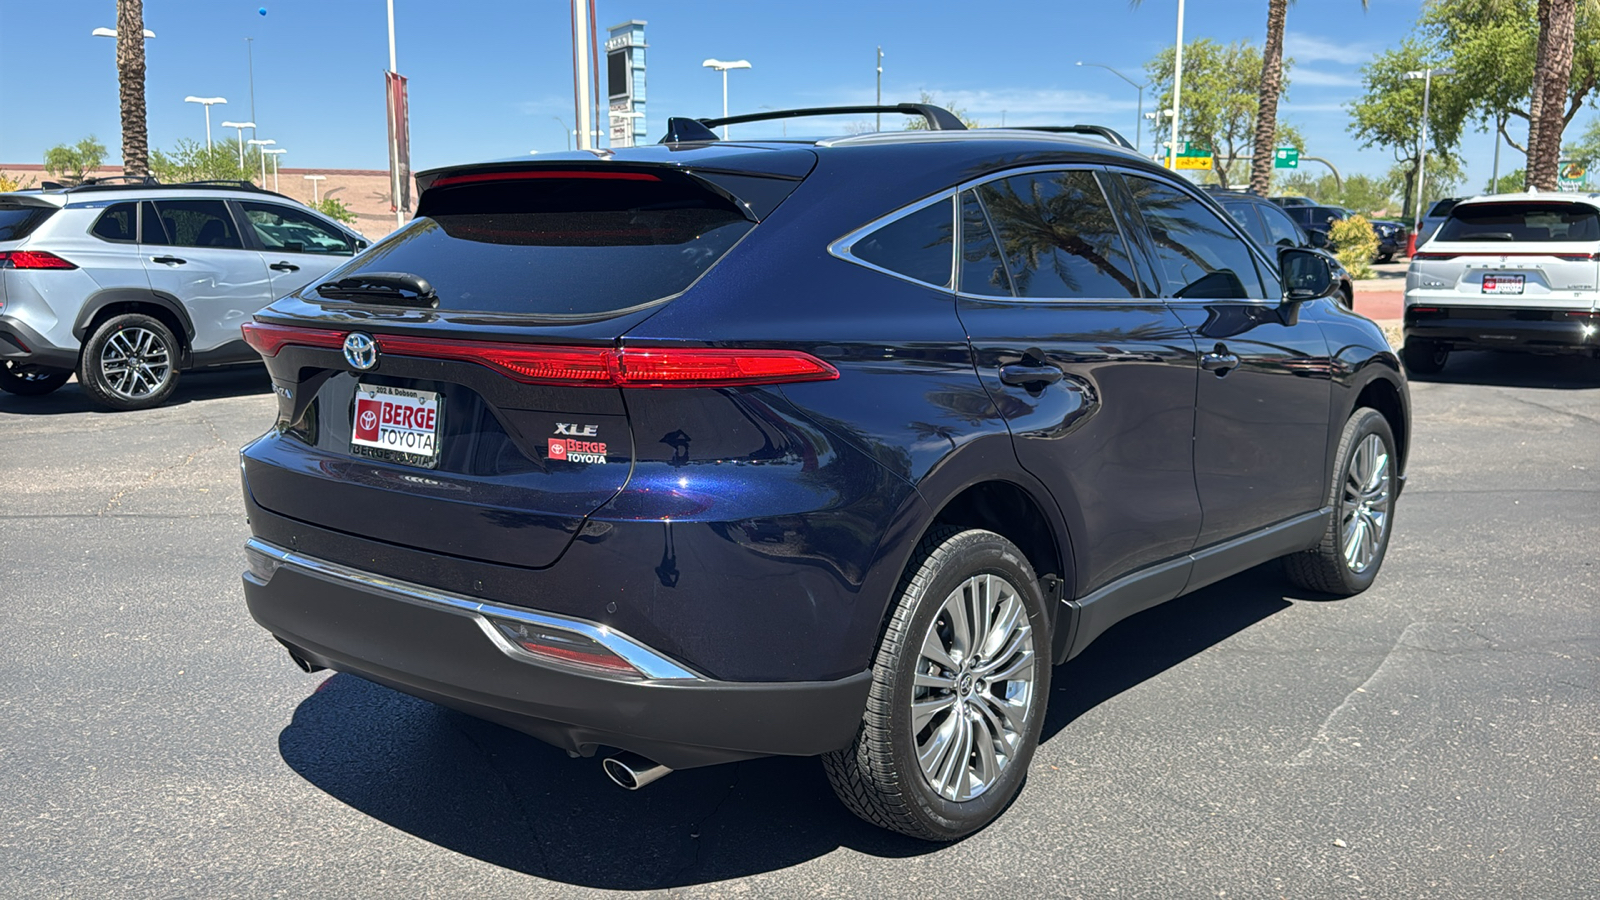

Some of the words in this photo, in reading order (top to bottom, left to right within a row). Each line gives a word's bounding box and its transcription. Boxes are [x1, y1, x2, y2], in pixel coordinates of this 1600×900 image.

[376, 386, 387, 394] 202
[394, 388, 418, 398] Dobson
[382, 402, 435, 430] BERGE
[553, 422, 599, 437] XLE
[380, 428, 433, 450] TOYOTA
[566, 438, 607, 454] BERGE
[353, 445, 390, 460] BERGE
[394, 452, 430, 466] TOYOTA
[567, 453, 607, 465] TOYOTA
